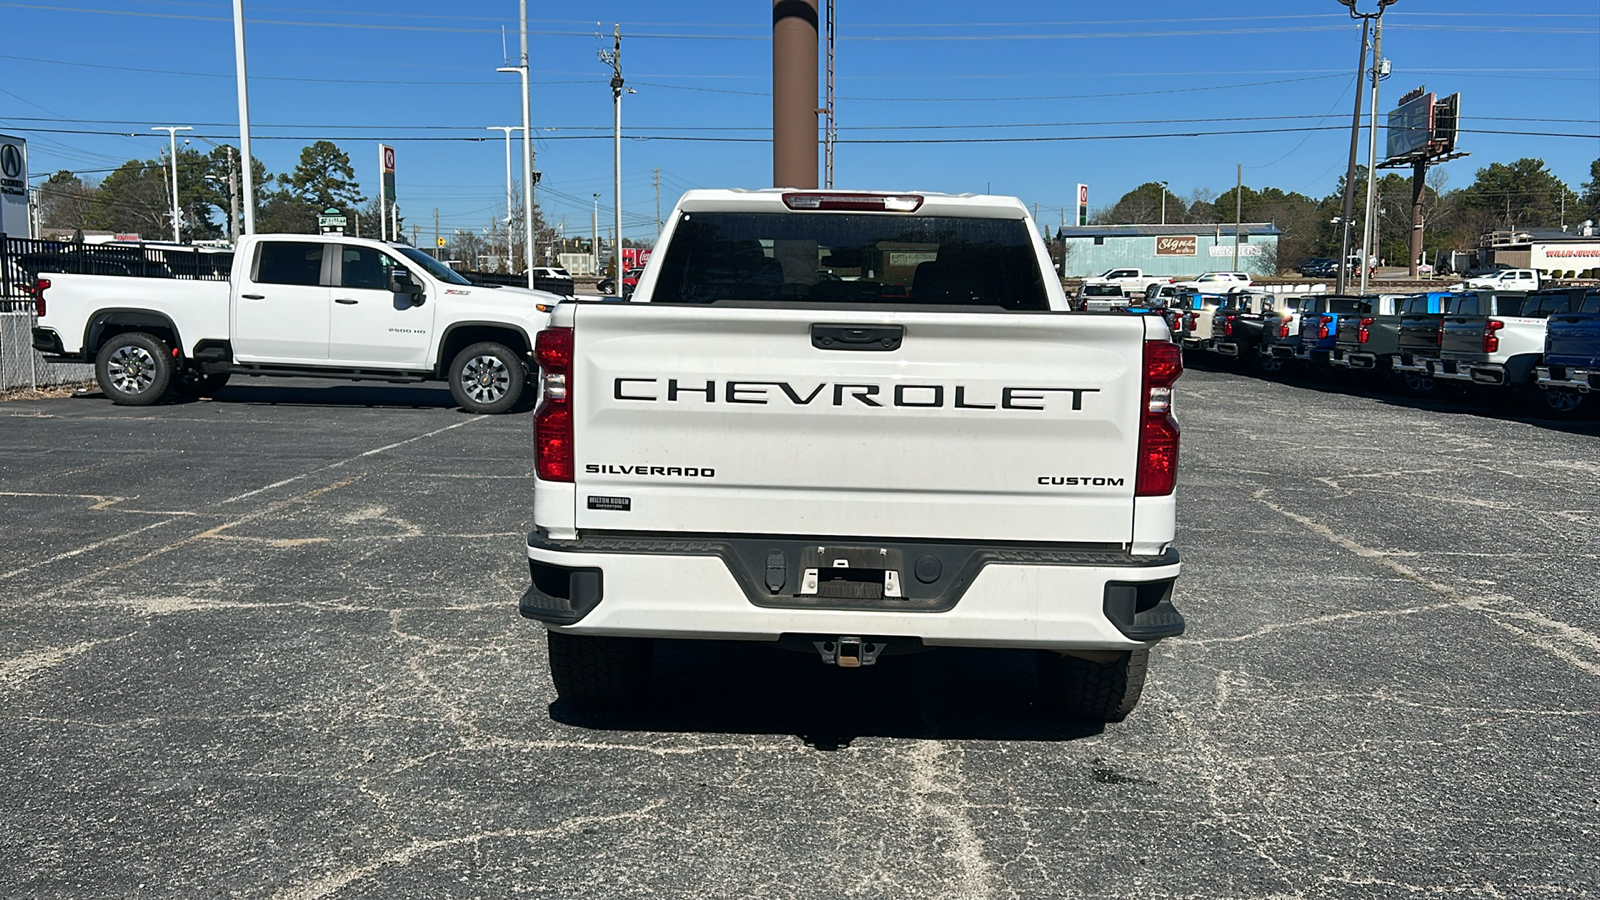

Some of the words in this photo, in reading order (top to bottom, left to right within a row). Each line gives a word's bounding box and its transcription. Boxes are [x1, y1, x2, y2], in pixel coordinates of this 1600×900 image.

[1210, 246, 1261, 256] BANERS
[614, 378, 1101, 411] CHEVROLET
[585, 464, 715, 478] SILVERADO
[1037, 476, 1124, 486] CUSTOM
[610, 497, 629, 505] RUBEN
